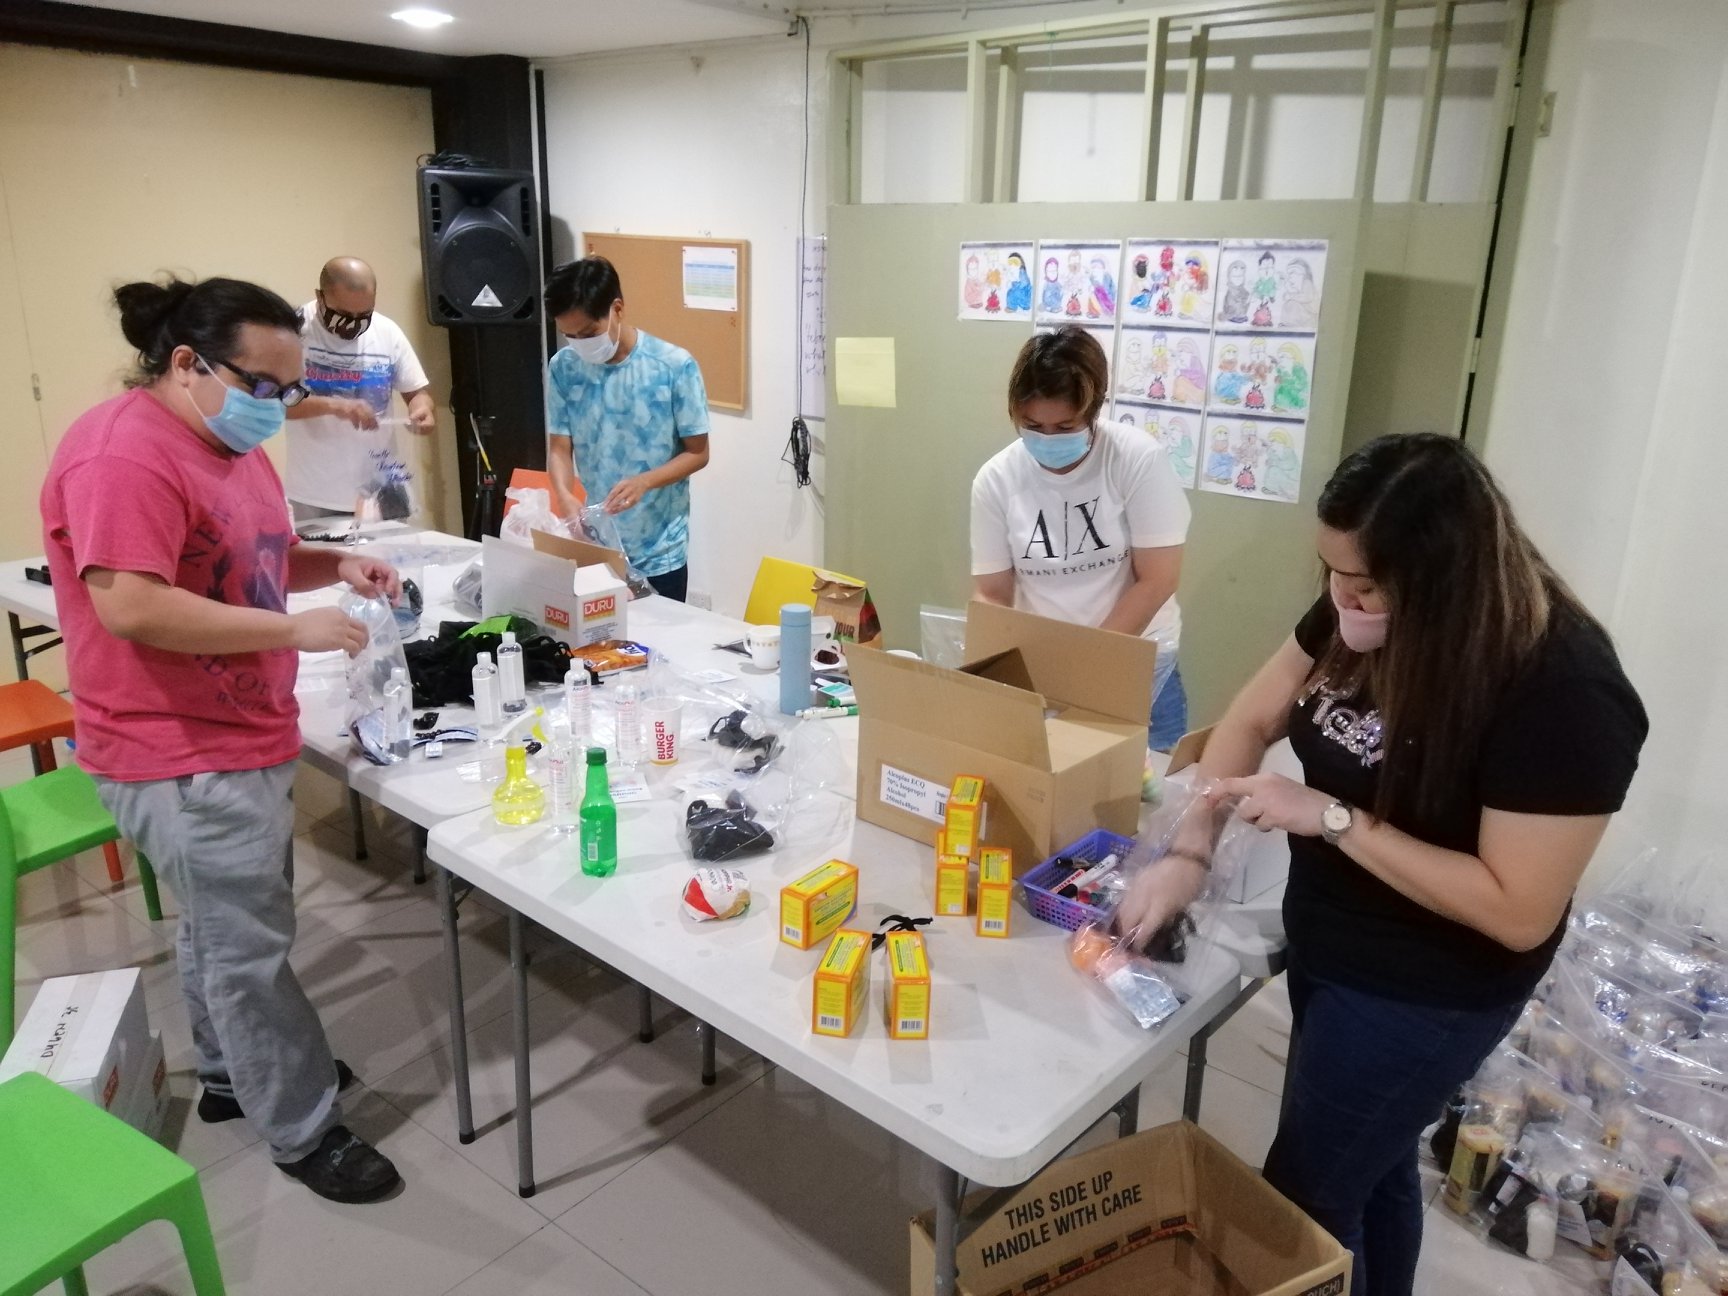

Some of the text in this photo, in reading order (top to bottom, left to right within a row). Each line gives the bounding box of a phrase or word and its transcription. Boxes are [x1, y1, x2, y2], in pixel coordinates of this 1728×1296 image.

[1062, 549, 1129, 575] EXCHANGE
[546, 607, 569, 624] DURU
[583, 598, 615, 615] DURU
[654, 721, 666, 760] BURGER
[666, 733, 675, 760] KING
[887, 776, 899, 788] 70%
[900, 782, 926, 798] Isopropyl
[887, 786, 907, 799] Alcohol
[911, 778, 926, 789] ECQ
[1004, 1170, 1113, 1230] THIS SIDE UP
[981, 1222, 1051, 1268] HANDLE
[1054, 1203, 1098, 1236] WITH
[1102, 1184, 1143, 1217] CARE
